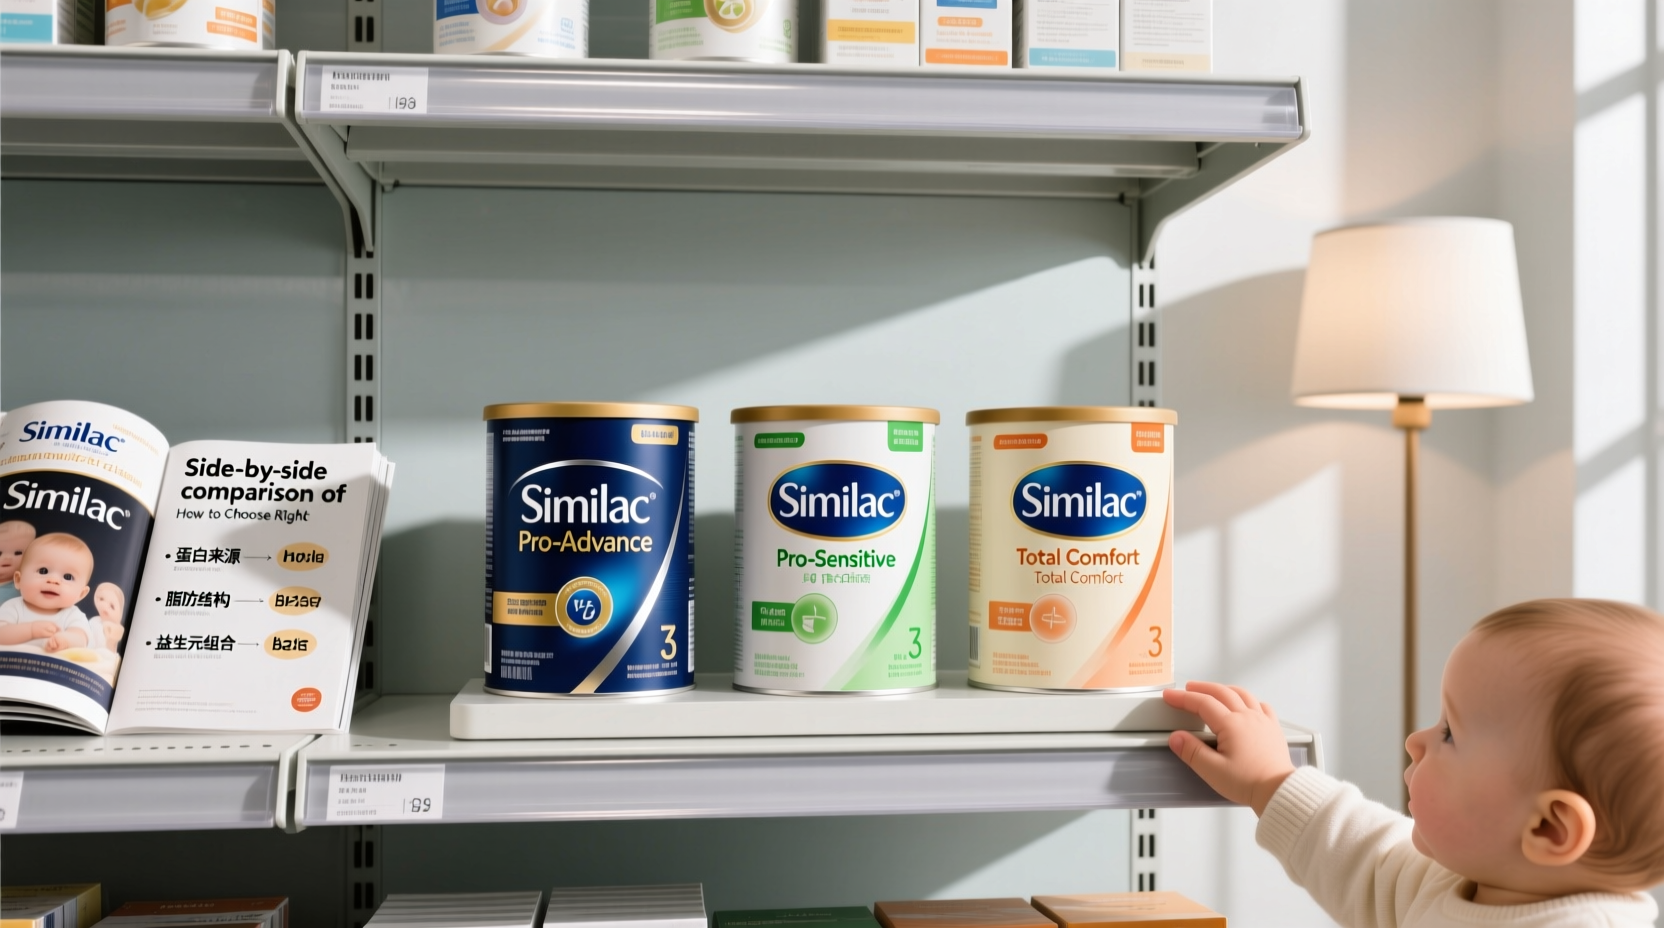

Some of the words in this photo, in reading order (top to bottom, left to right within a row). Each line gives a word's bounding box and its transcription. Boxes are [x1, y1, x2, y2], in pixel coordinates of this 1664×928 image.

[184, 457, 328, 483] Side-by-side
[181, 482, 314, 505] comparison
[321, 483, 348, 503] of
[208, 508, 221, 520] to
[224, 508, 271, 521] Choose
[518, 530, 653, 553] Pro-Advance
[776, 549, 897, 568] Pro-Sensitive
[1016, 547, 1061, 566] Total
[1066, 547, 1141, 566] Comfort
[1035, 570, 1067, 585] Total
[154, 633, 236, 652] 益生元组合
[660, 624, 678, 661] 3
[908, 627, 922, 660] 3
[1147, 625, 1163, 658] 3
